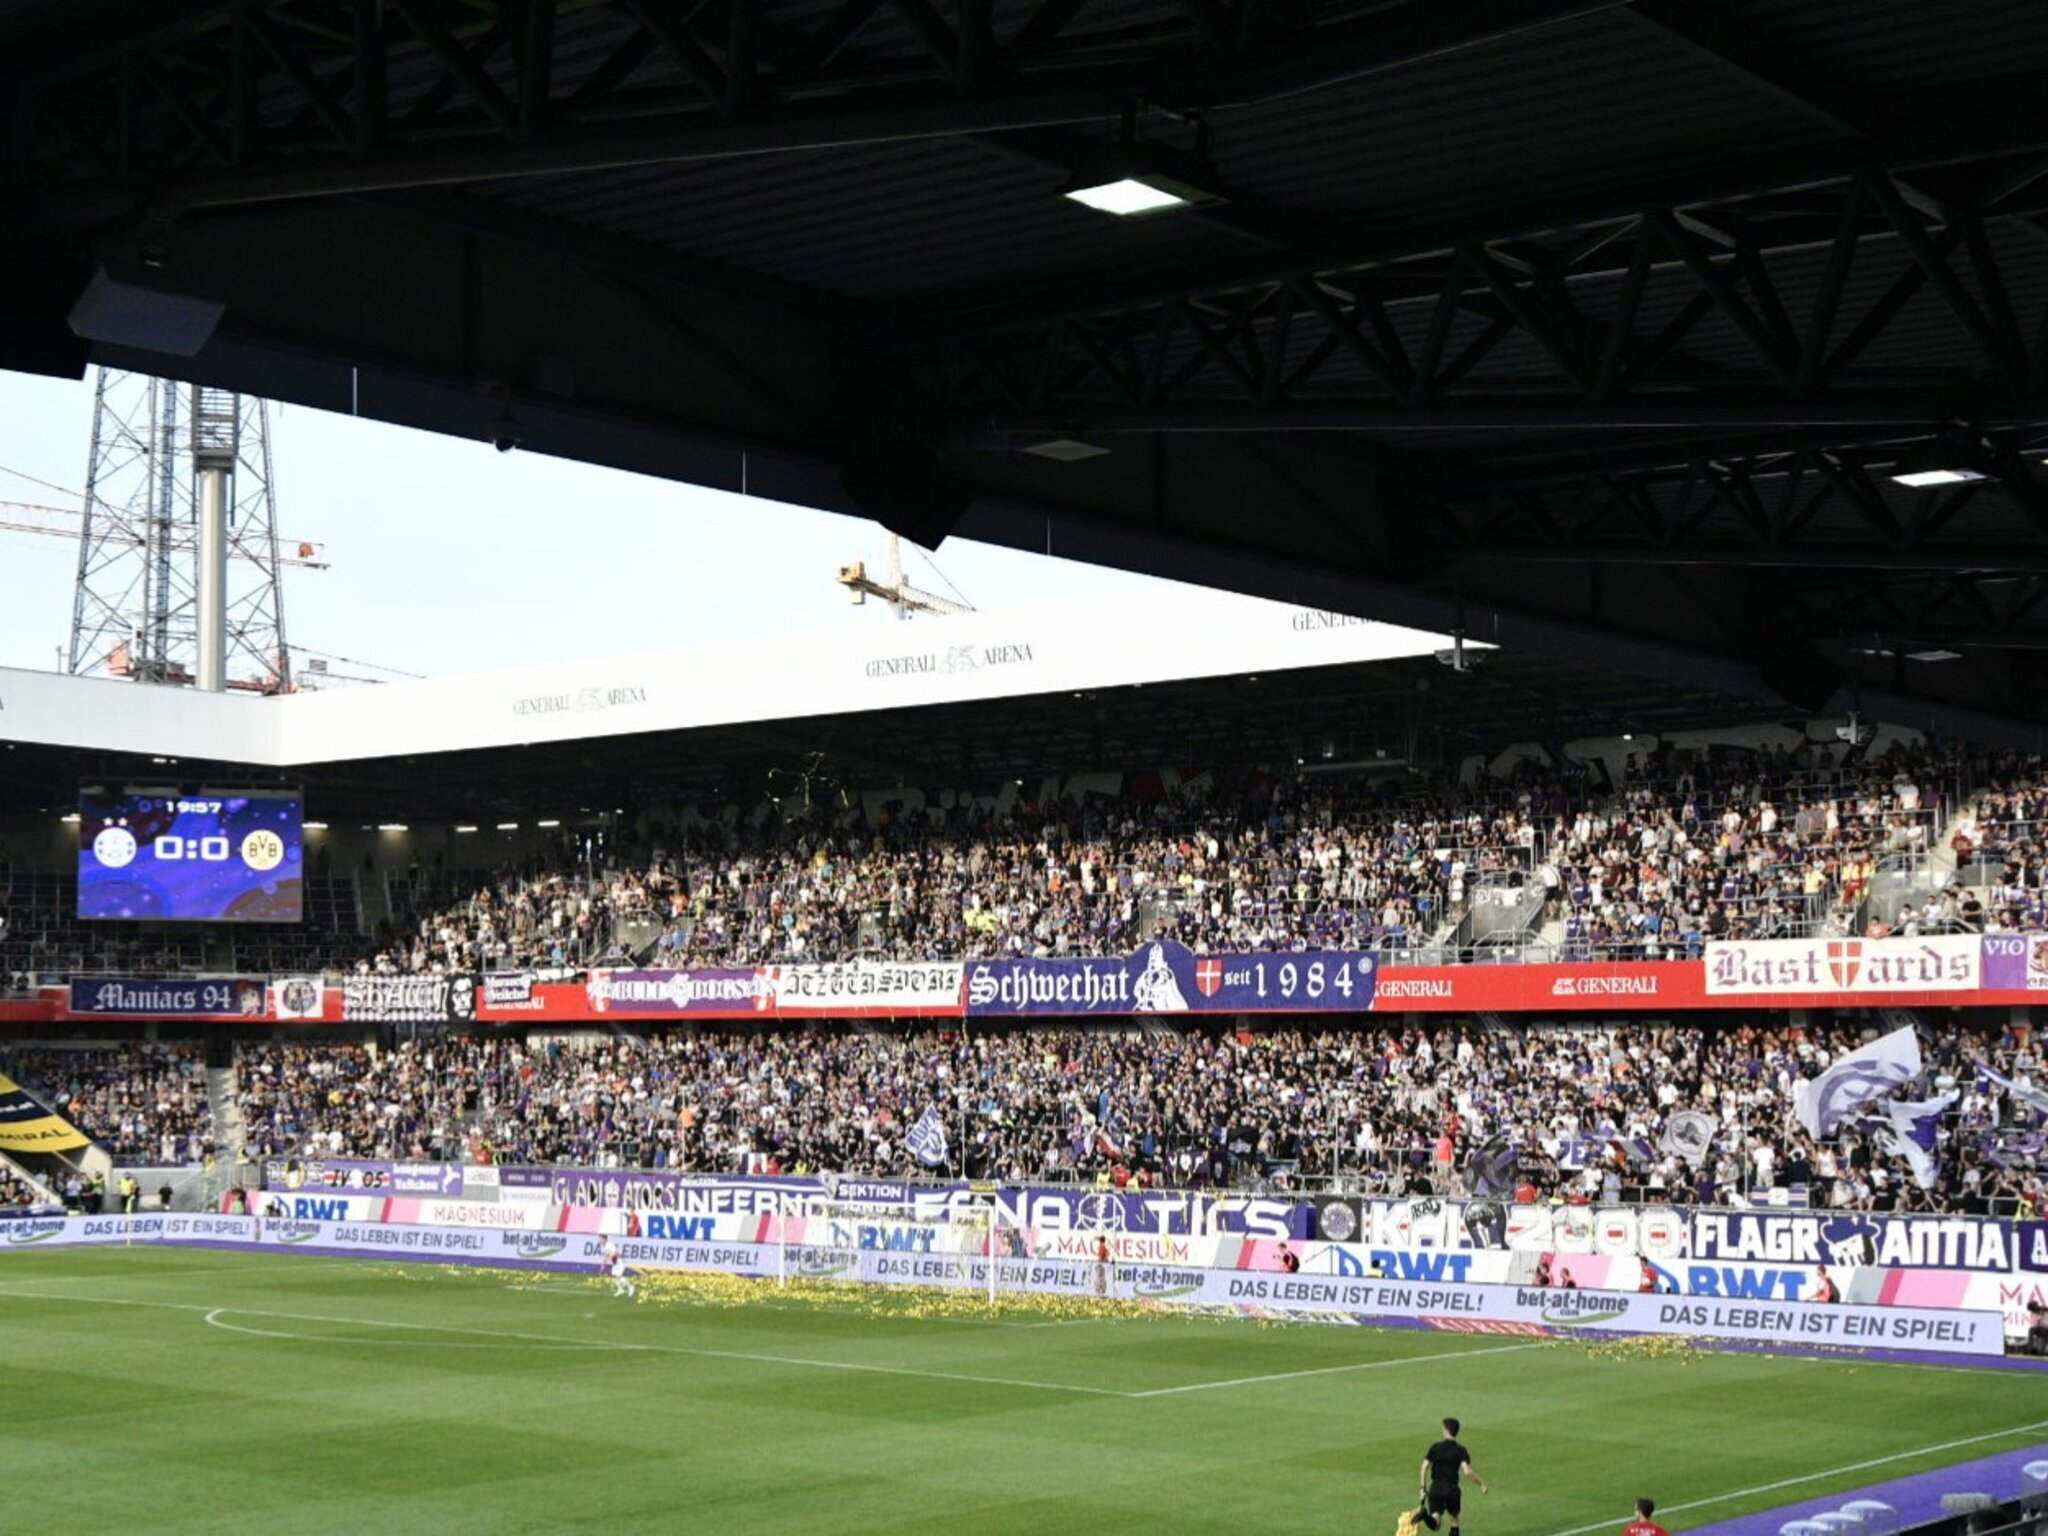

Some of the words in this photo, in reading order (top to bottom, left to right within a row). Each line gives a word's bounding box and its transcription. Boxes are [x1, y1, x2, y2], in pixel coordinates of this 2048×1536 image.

[866, 655, 936, 678] GENERALI
[1041, 643, 1093, 666] ARENA
[513, 695, 569, 716] GENERALI
[606, 687, 647, 705] ARENA
[155, 836, 230, 861] 0:0
[1984, 939, 2025, 956] VIO
[1713, 948, 1820, 986] Bast
[968, 964, 1130, 1010] Schwechat
[1224, 969, 1251, 987] seit
[1380, 980, 1454, 998] GENERALI
[1577, 975, 1657, 994] GENERALI
[94, 984, 197, 1011] Maniacs
[203, 985, 233, 1010] 94
[838, 1184, 901, 1199] SEKTION
[265, 1219, 321, 1235] bet-at-home
[434, 1206, 526, 1225] MAGNESIUM
[84, 1222, 113, 1236] DAS
[116, 1219, 164, 1234] LEBEN
[166, 1219, 190, 1233] IST
[192, 1220, 213, 1234] EIN
[215, 1221, 250, 1236] SPIEL!
[335, 1227, 357, 1242] DAS
[360, 1228, 399, 1244] LEBEN
[402, 1231, 422, 1246] IST
[423, 1232, 441, 1247] EIN
[444, 1233, 485, 1249] SPIEL!
[502, 1232, 567, 1247] bet-at-home
[661, 1244, 683, 1260] IST
[686, 1246, 710, 1262] EIN
[713, 1247, 759, 1266] SPIEL!
[878, 1258, 909, 1275] DAS
[1031, 1267, 1087, 1287] SPIEL!
[1228, 1279, 1269, 1299] DAS
[1273, 1281, 1338, 1303] LEBEN
[1342, 1286, 1374, 1305] IST
[1377, 1288, 1412, 1308] EIN
[1416, 1290, 1484, 1312] SPIEL!
[1516, 1288, 1629, 1313] bet-at-home
[1659, 1304, 1708, 1326] DAS
[1713, 1306, 1795, 1331] LEBEN
[1799, 1312, 1838, 1335] IST
[1843, 1315, 1887, 1338] EIN
[1892, 1318, 1977, 1343] SPIEL!
